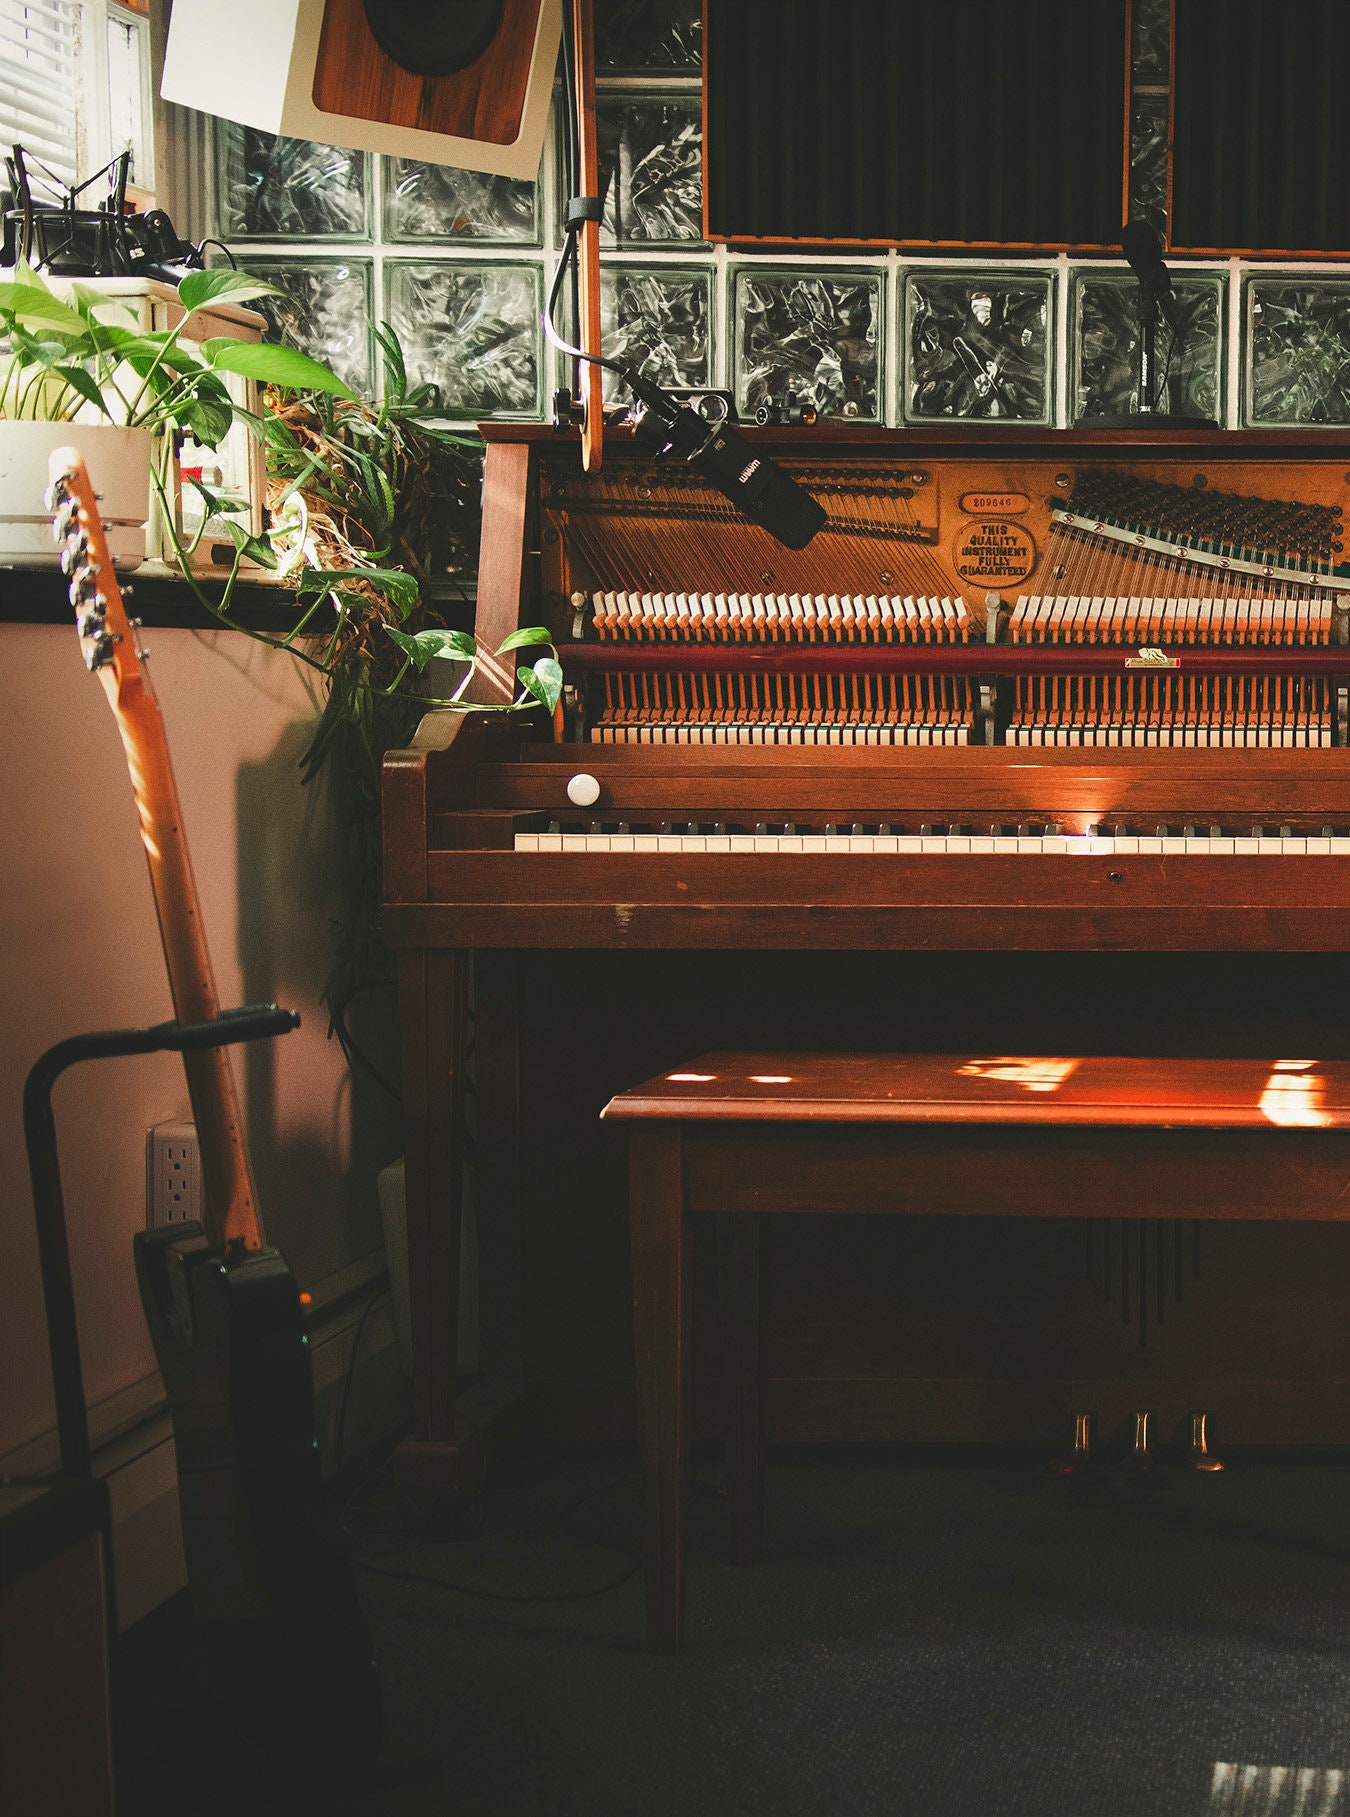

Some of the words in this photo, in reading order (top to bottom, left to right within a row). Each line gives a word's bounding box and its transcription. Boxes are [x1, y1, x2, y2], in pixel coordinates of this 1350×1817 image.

[981, 525, 1008, 535] THIS
[969, 535, 1019, 547] QUALITY
[961, 546, 1028, 557] INSTRUMENT
[978, 556, 1011, 567] FULLY
[960, 565, 1027, 576] GUARANTEED
